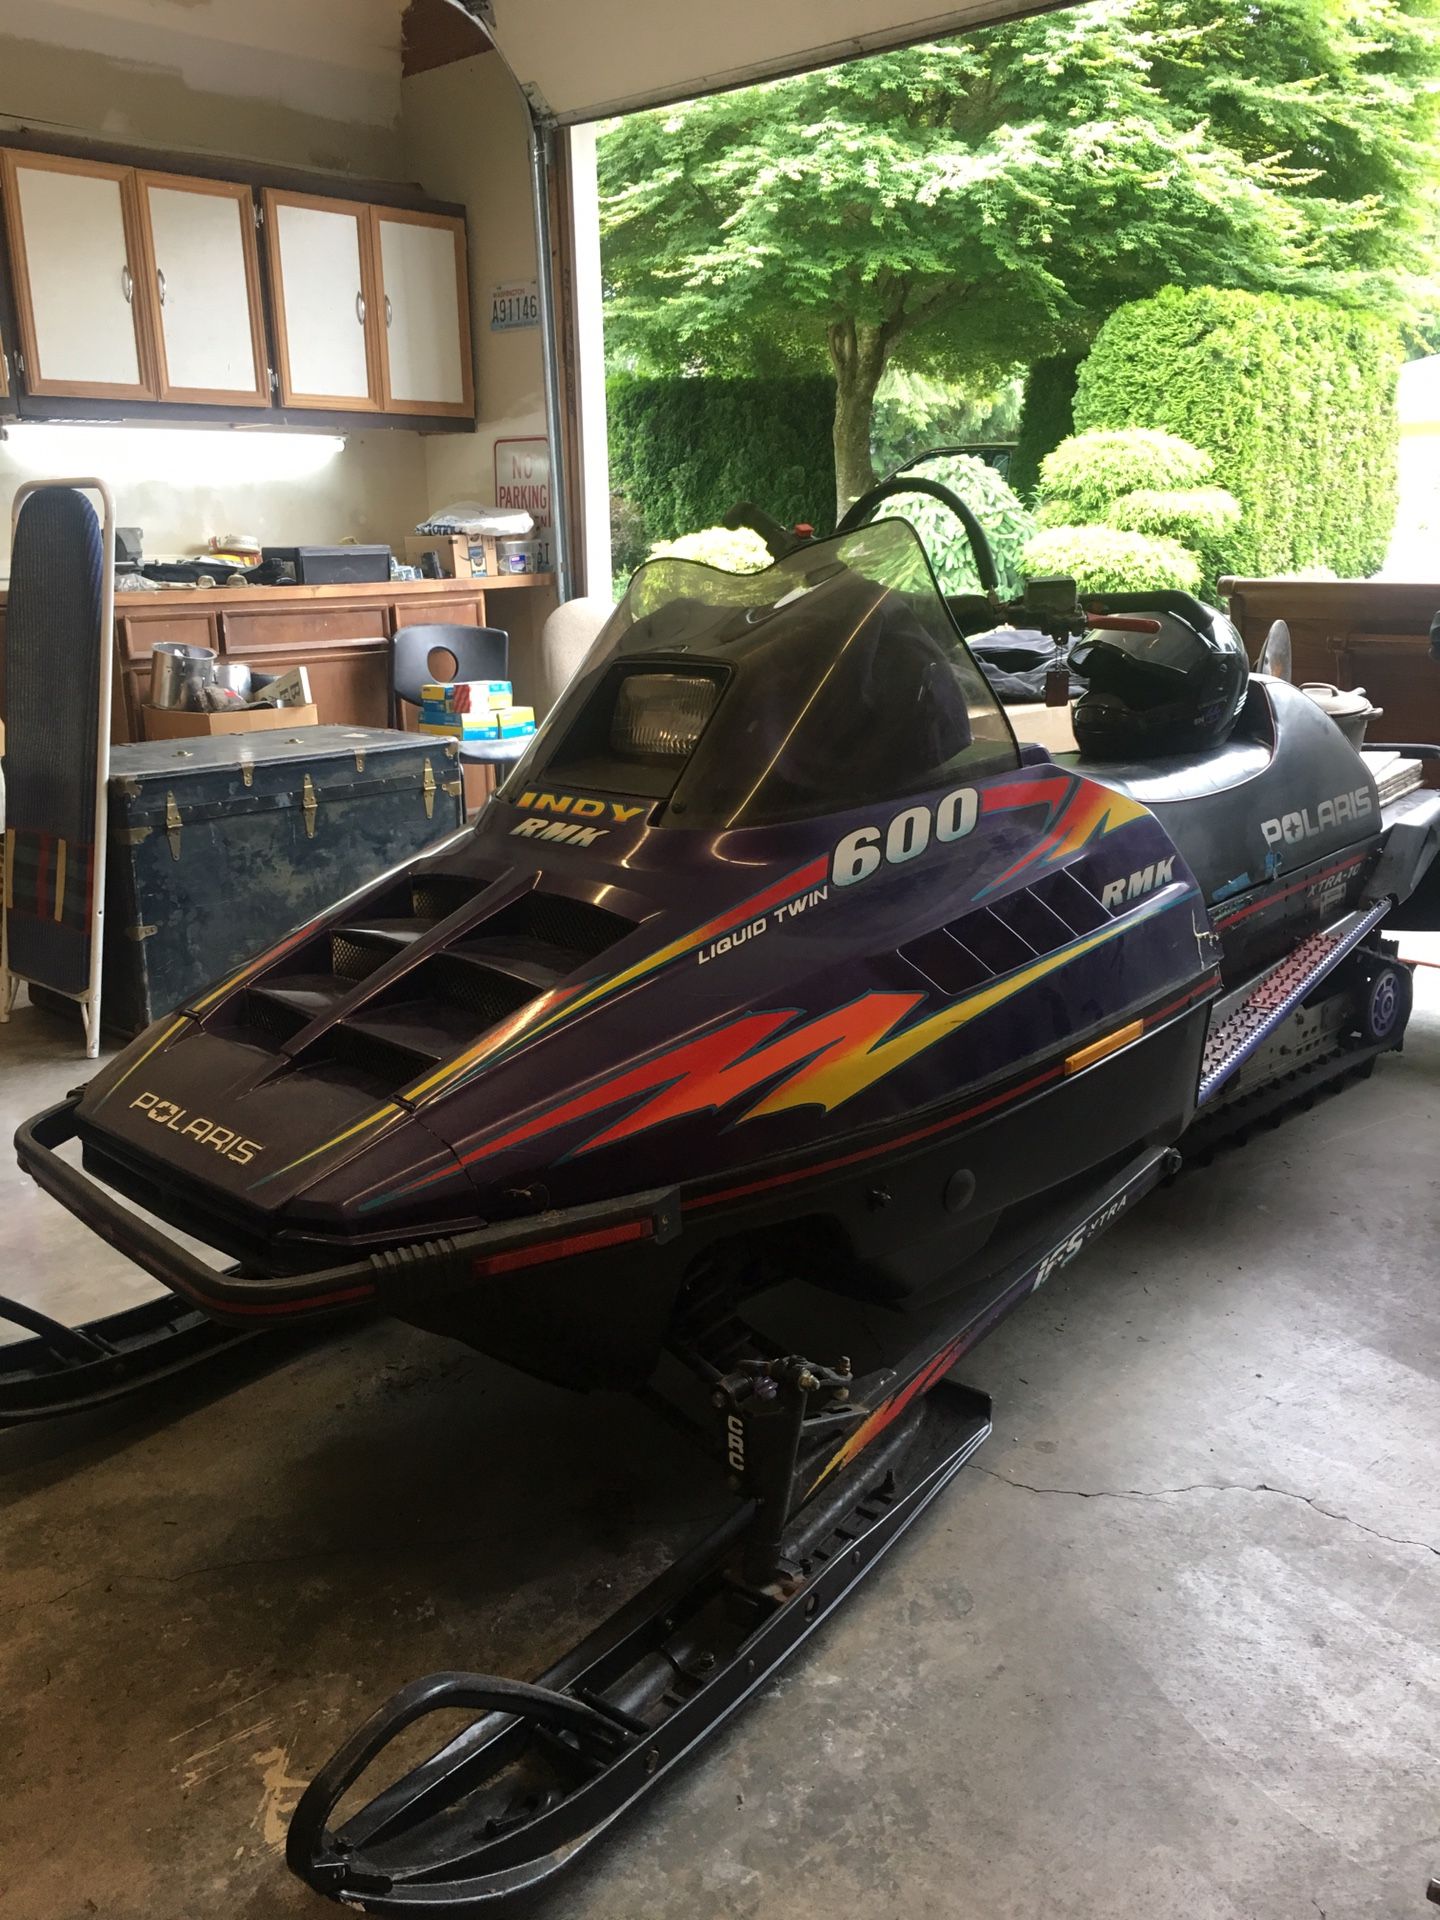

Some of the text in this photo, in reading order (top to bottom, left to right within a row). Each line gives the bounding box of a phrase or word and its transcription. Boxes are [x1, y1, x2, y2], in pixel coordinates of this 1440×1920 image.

[492, 295, 537, 324] A91146
[512, 455, 533, 480] NO
[499, 484, 547, 510] PARKING
[508, 817, 611, 848] RMK
[516, 792, 645, 823] INDY
[1260, 785, 1373, 846] POLARIS
[831, 787, 979, 888] 600
[1100, 855, 1177, 911] RMK
[698, 885, 829, 965] LIQUID TWIN
[128, 1091, 266, 1165] POLARIS
[727, 1414, 745, 1471] CRC
